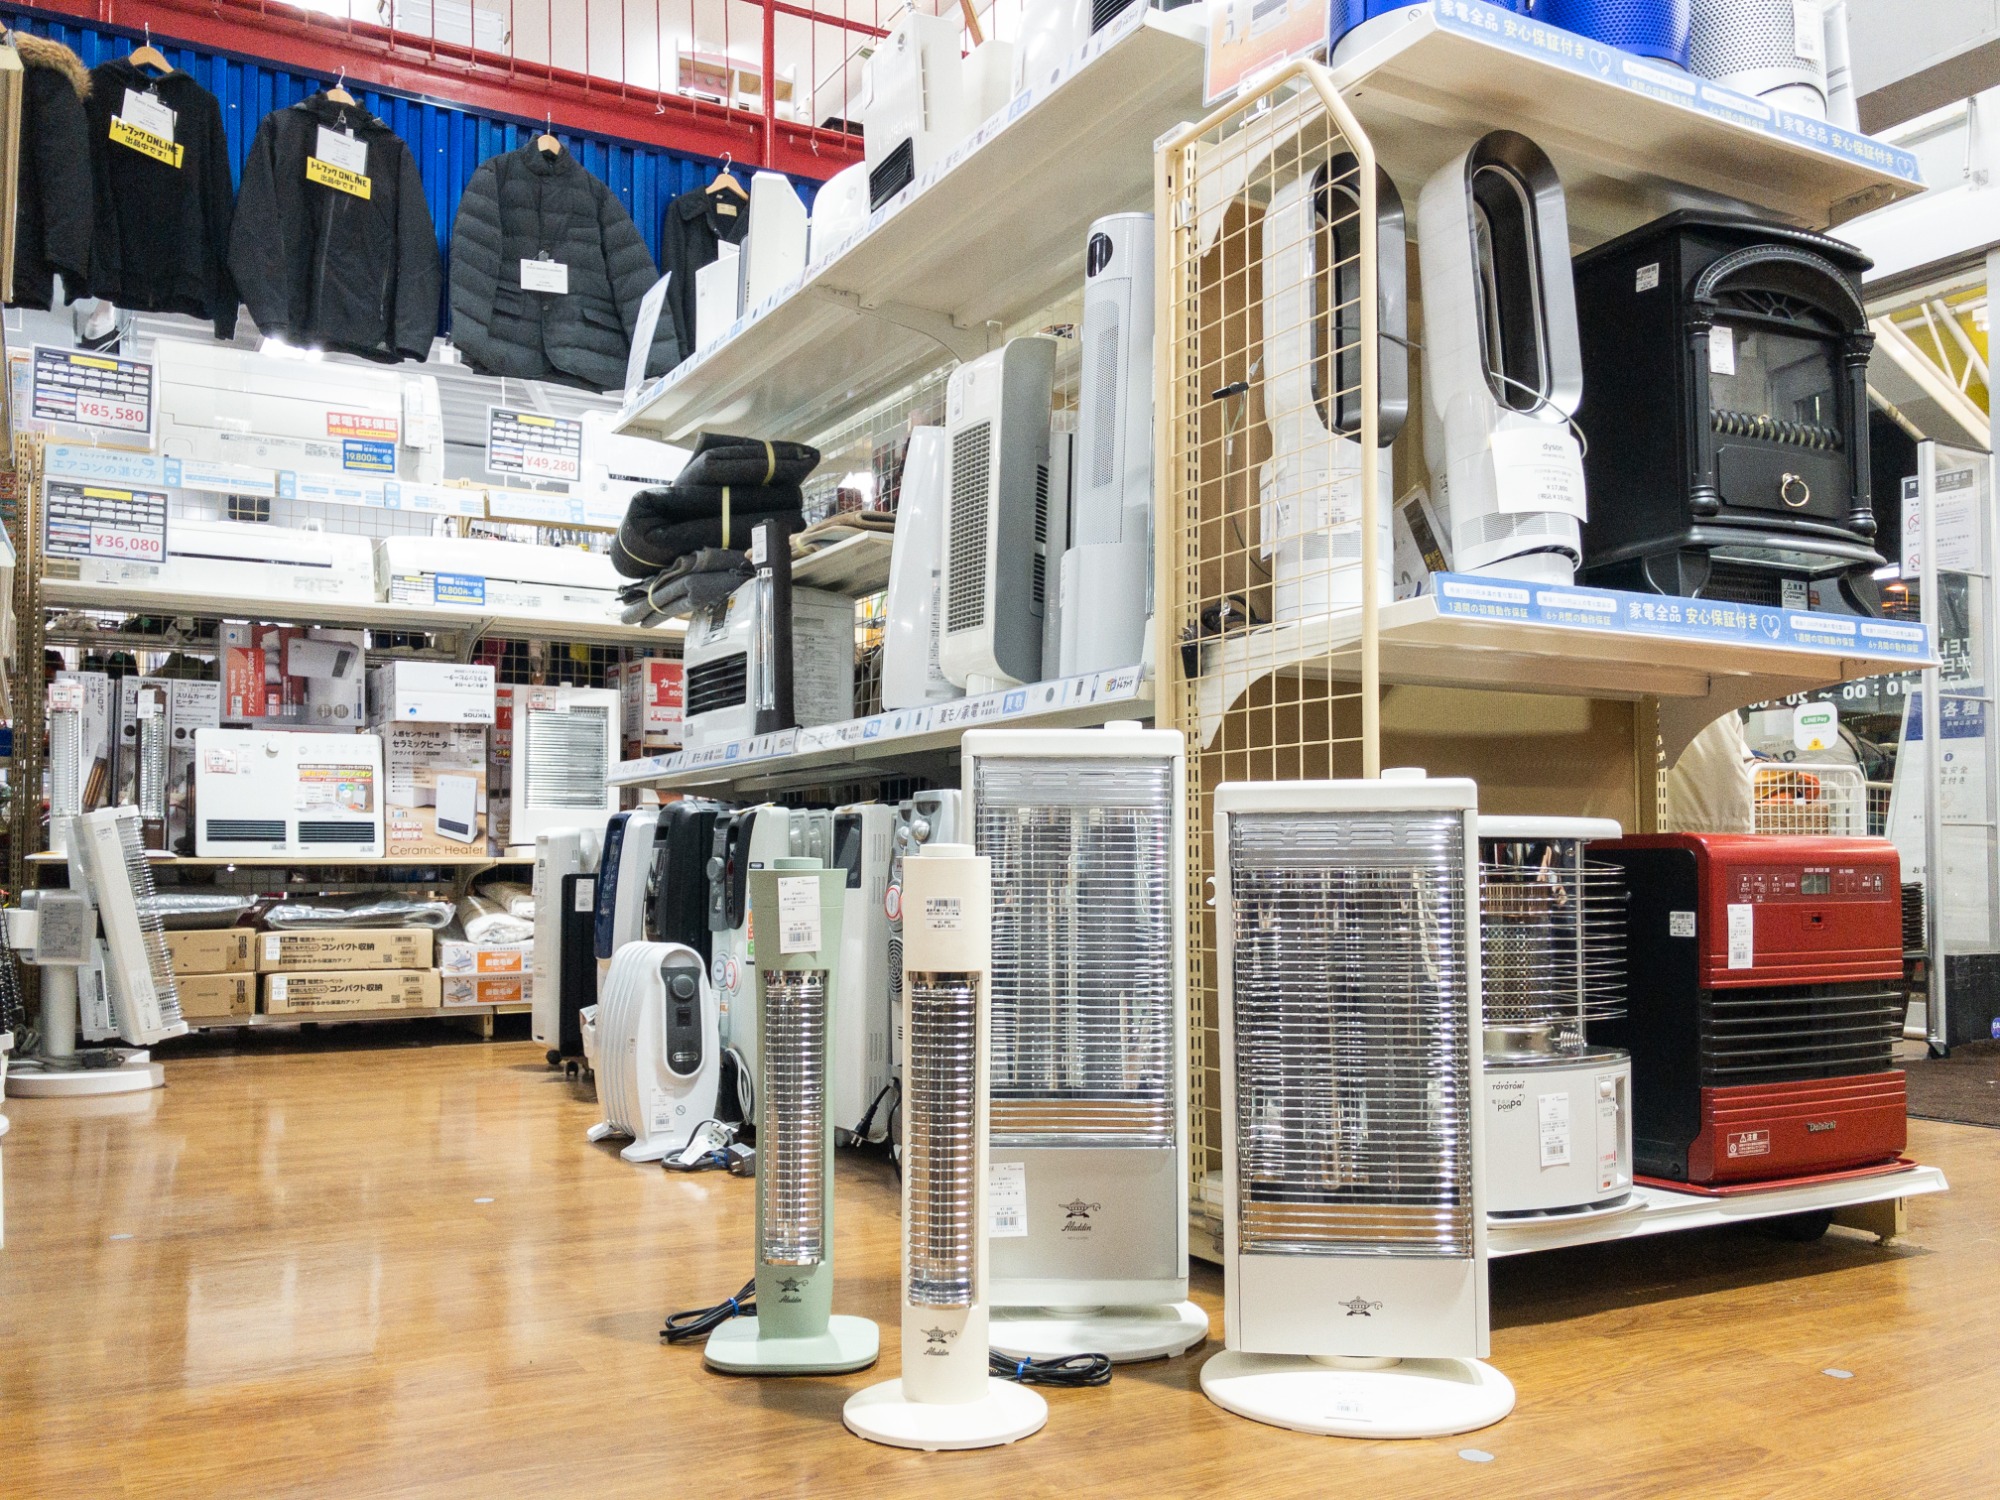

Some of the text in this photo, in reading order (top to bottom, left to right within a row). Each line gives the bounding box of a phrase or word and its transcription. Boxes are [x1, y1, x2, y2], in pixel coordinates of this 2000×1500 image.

[1441, 2, 1585, 60] 家電全品 安心保証付き
[114, 121, 179, 156] トレファク ONLINE
[1783, 115, 1894, 167] 家電全品 安心保証付き
[311, 161, 367, 188] トレファク ONLINE
[80, 402, 144, 423] ¥85,580
[329, 414, 397, 430] 家電1年保証
[1543, 443, 1563, 451] dyson
[53, 459, 159, 480] エアコンの選び方
[526, 455, 576, 473] ¥49,280
[94, 534, 160, 553] ¥36,080
[1448, 602, 1528, 618] 1週間の初期動作保証
[1629, 602, 1757, 629] 家電全品 安心保証付き
[1546, 611, 1611, 626] 6ヶ月間の動作保証
[939, 702, 980, 723] 夏モノ家電
[392, 740, 456, 749] セラミックヒーター
[390, 844, 484, 856] Ceramic Heater
[321, 943, 375, 951] コンパクト収納
[330, 984, 382, 993] コンパクト収納
[1492, 1080, 1525, 1090] TOYOTOMI
[1061, 1221, 1092, 1232] Aladdin
[778, 1294, 802, 1303] Aladdin
[923, 1346, 950, 1356] Aladdin
